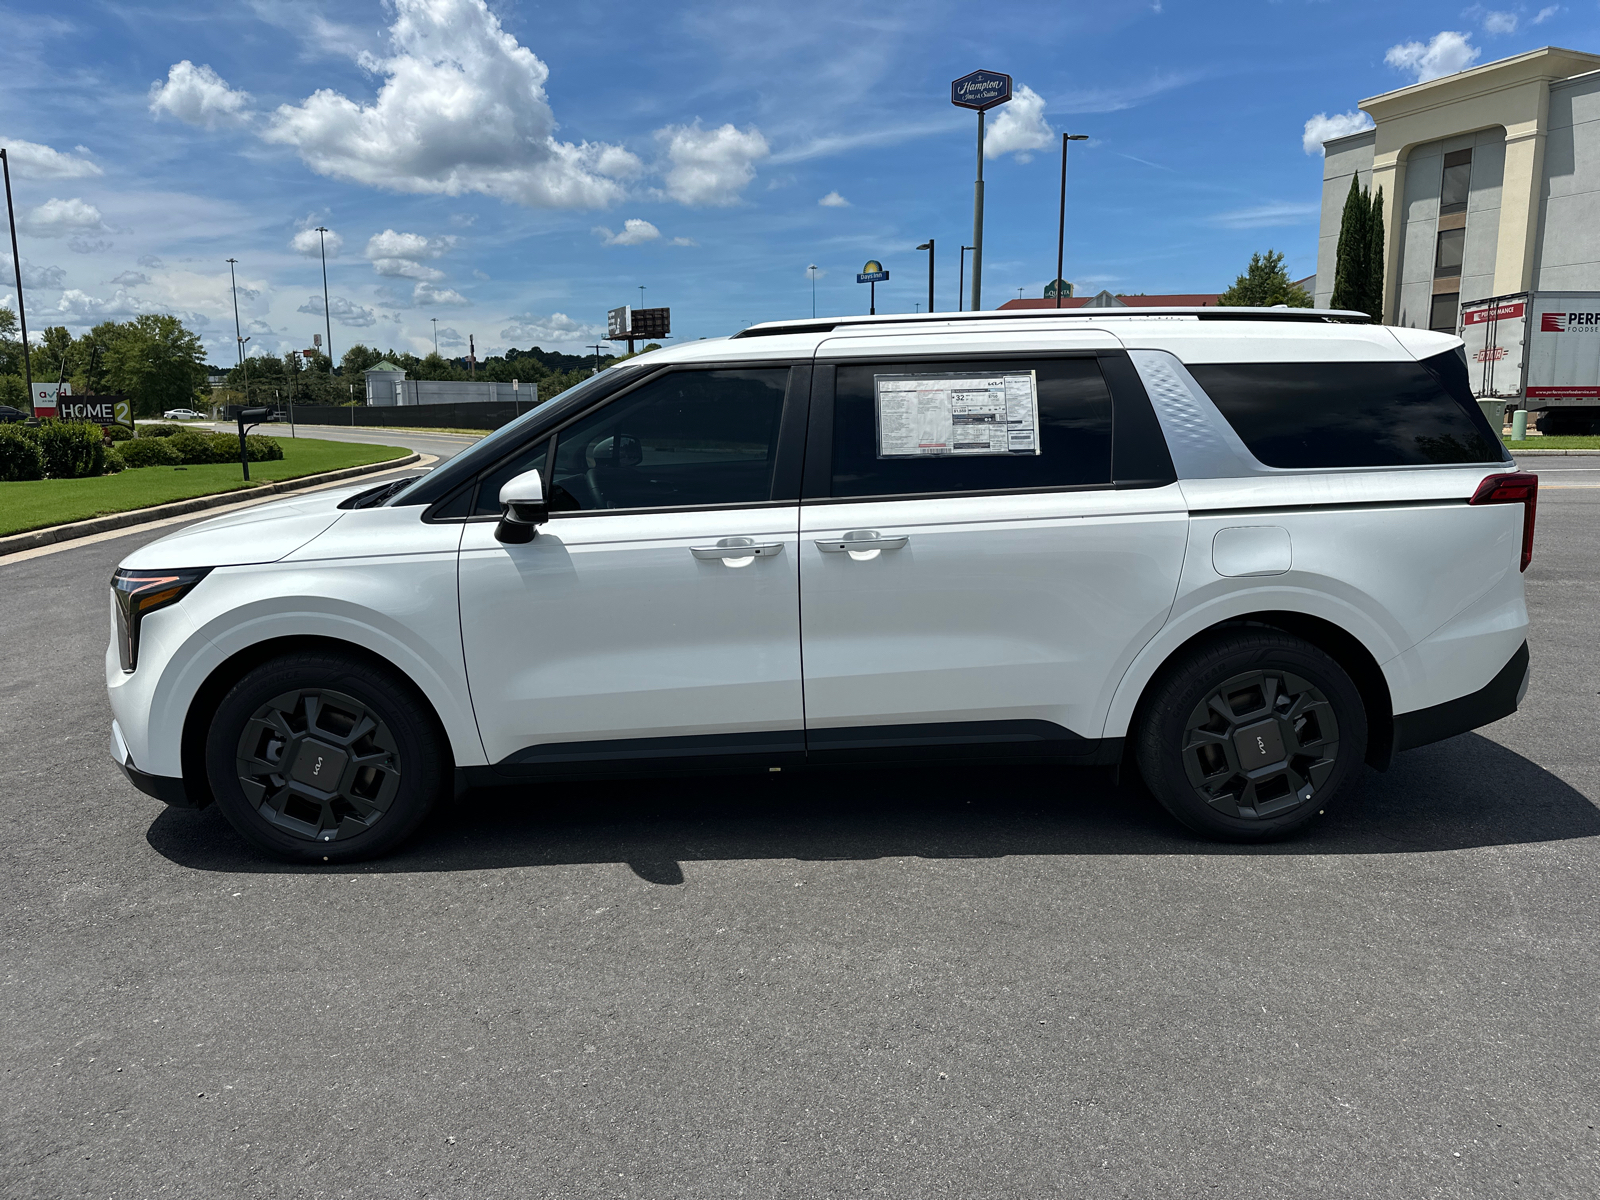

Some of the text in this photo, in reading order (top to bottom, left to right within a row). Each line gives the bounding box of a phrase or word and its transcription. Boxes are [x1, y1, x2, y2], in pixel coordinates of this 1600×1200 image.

[957, 80, 1003, 94] Hampton
[1568, 313, 1600, 325] PERF
[62, 404, 113, 418] HOME
